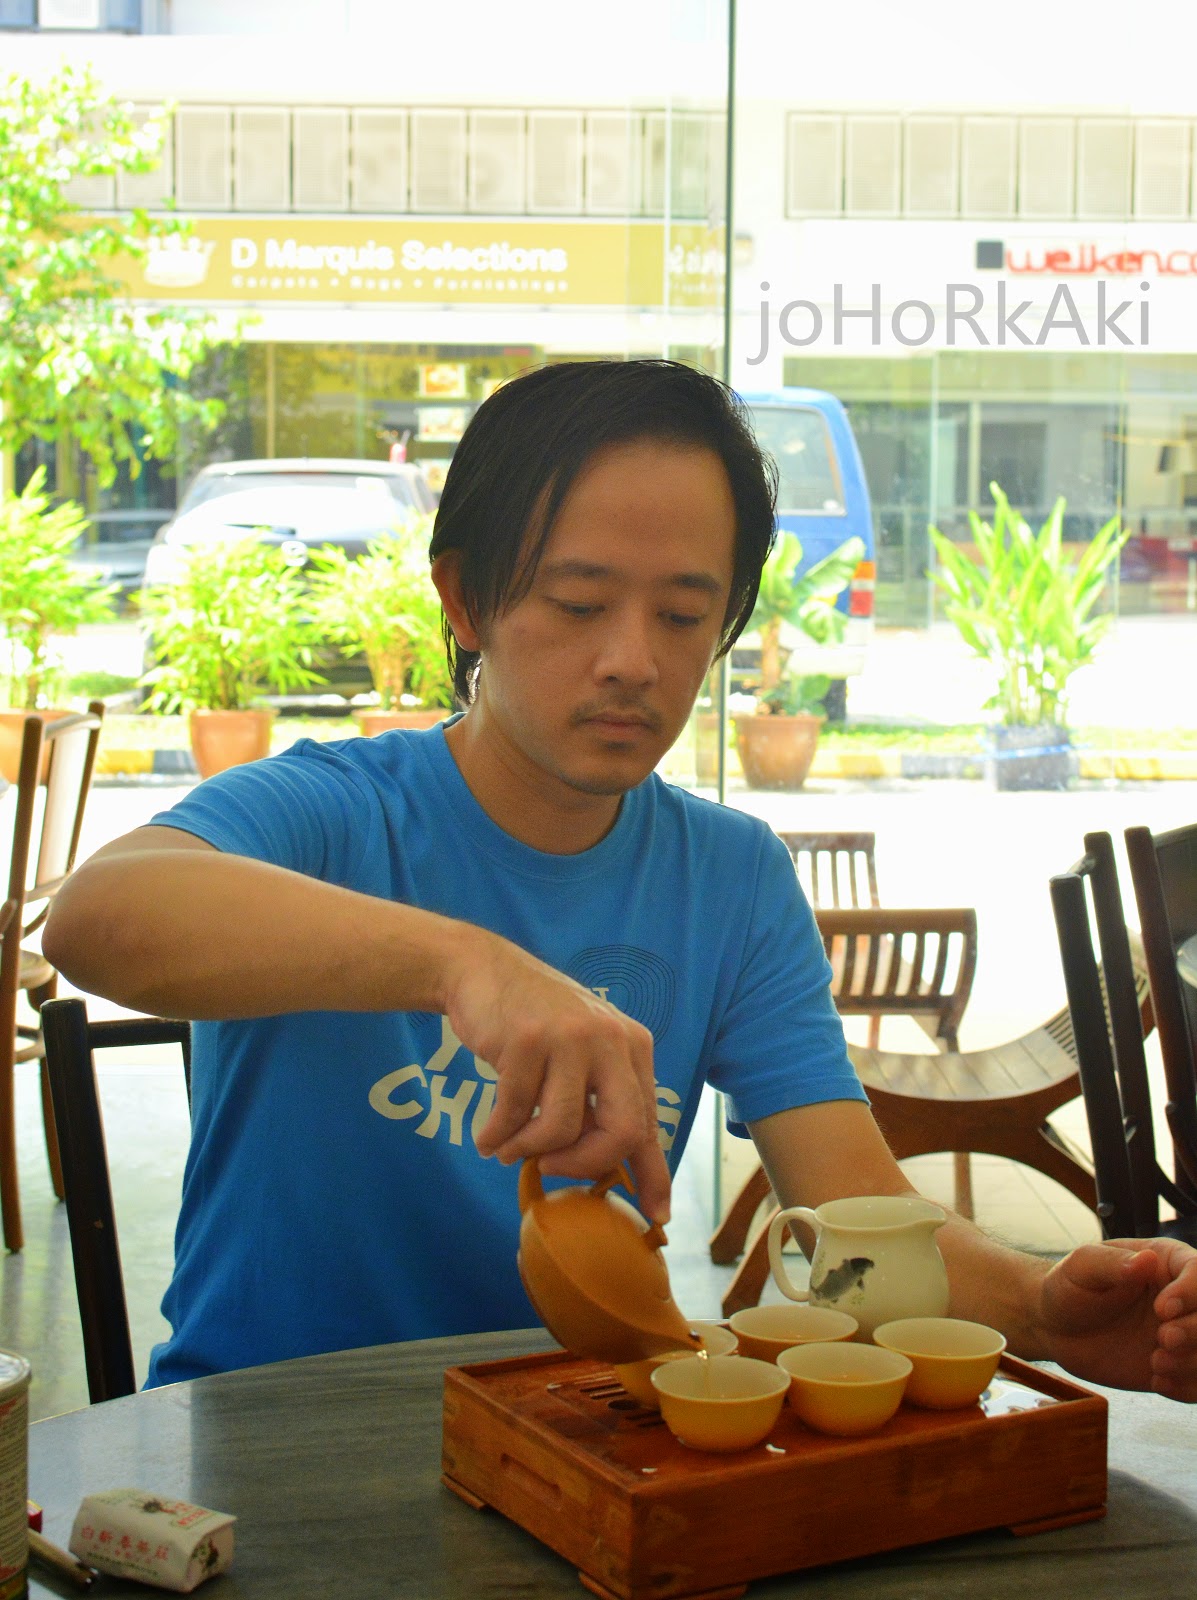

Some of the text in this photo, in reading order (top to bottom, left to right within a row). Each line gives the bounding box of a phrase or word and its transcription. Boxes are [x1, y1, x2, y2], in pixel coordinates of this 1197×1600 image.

[230, 237, 569, 274] D Marquis Selections
